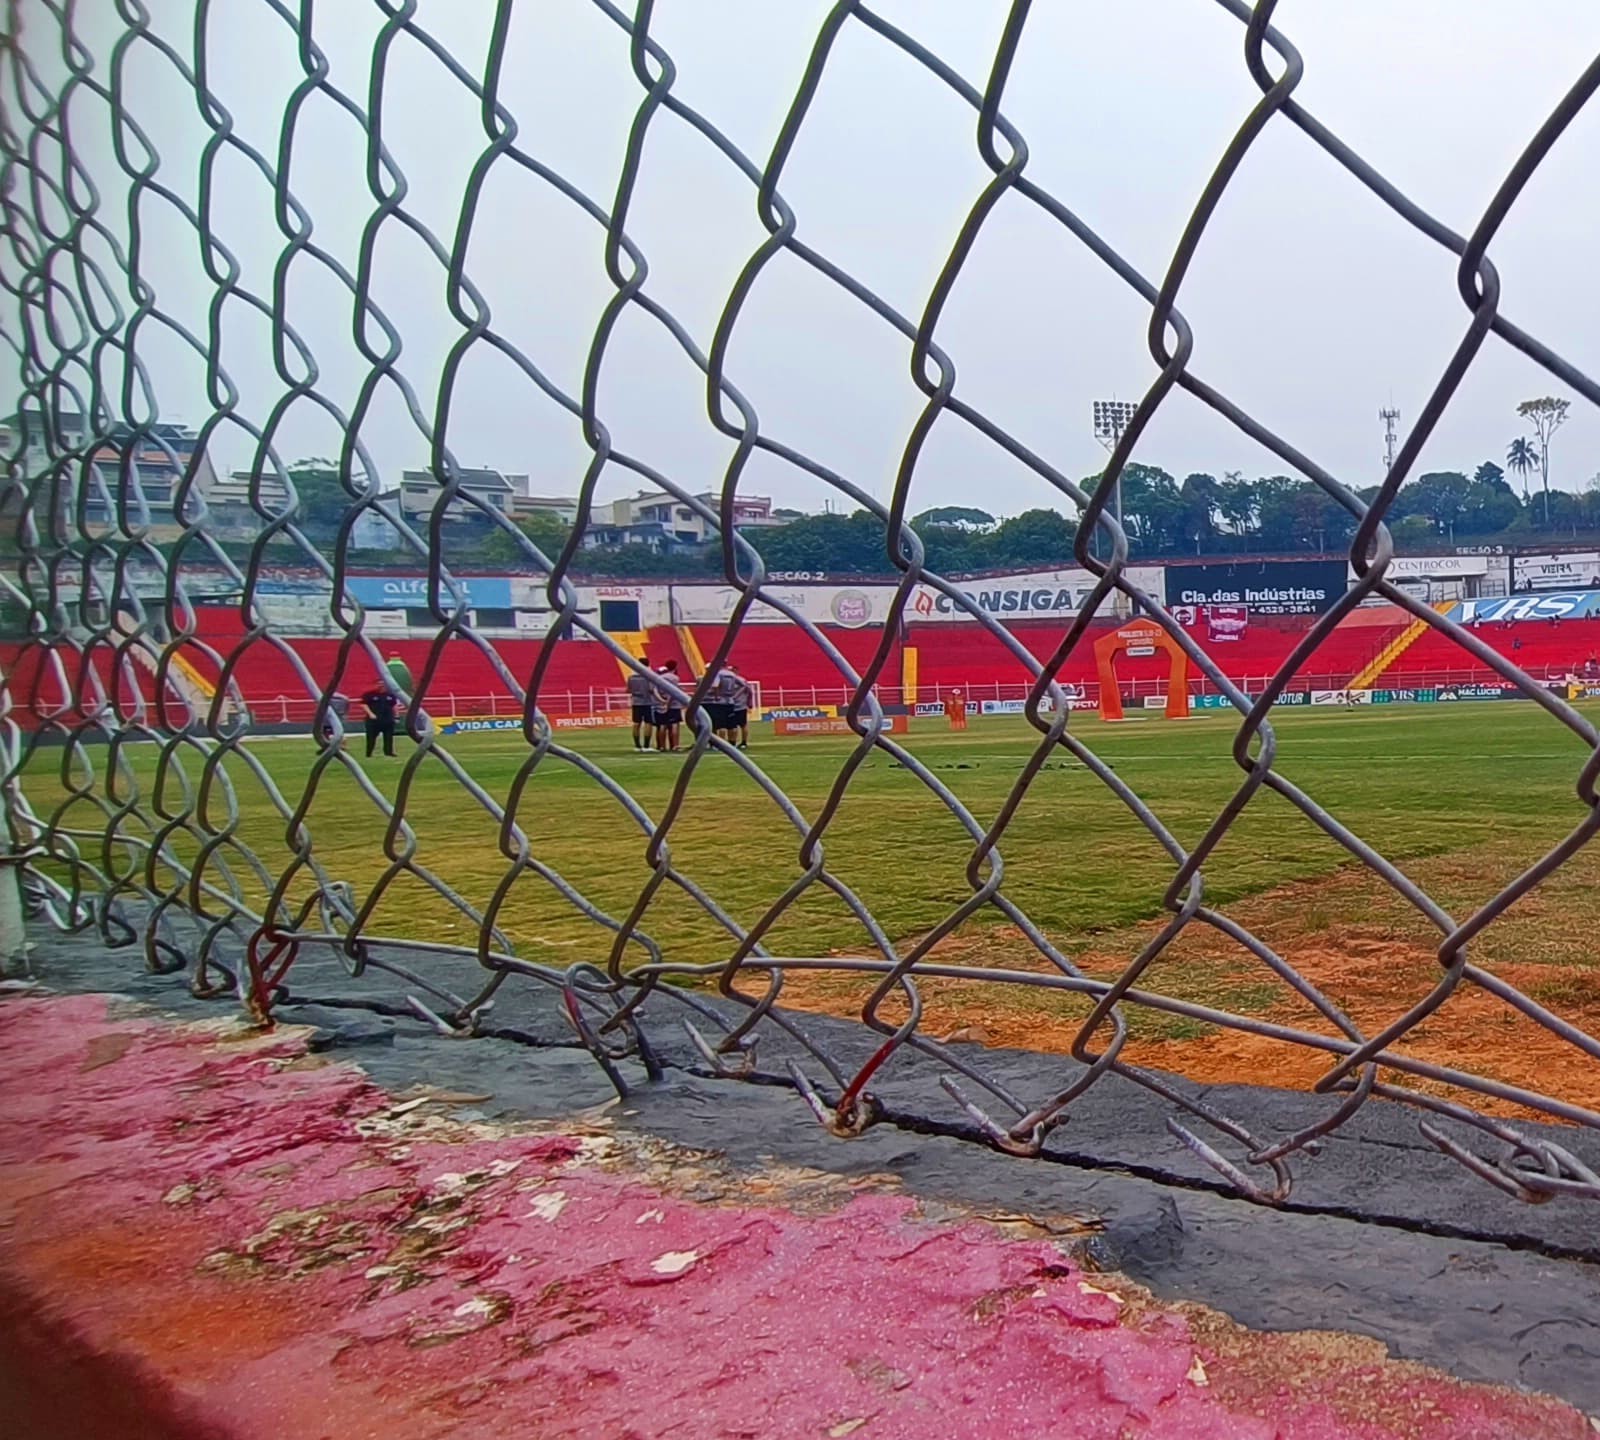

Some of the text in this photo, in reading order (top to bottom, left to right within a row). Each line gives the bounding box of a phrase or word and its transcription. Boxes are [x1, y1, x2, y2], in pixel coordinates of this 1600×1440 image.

[1392, 690, 1415, 699] VRS
[456, 720, 522, 730] VIDA CAP
